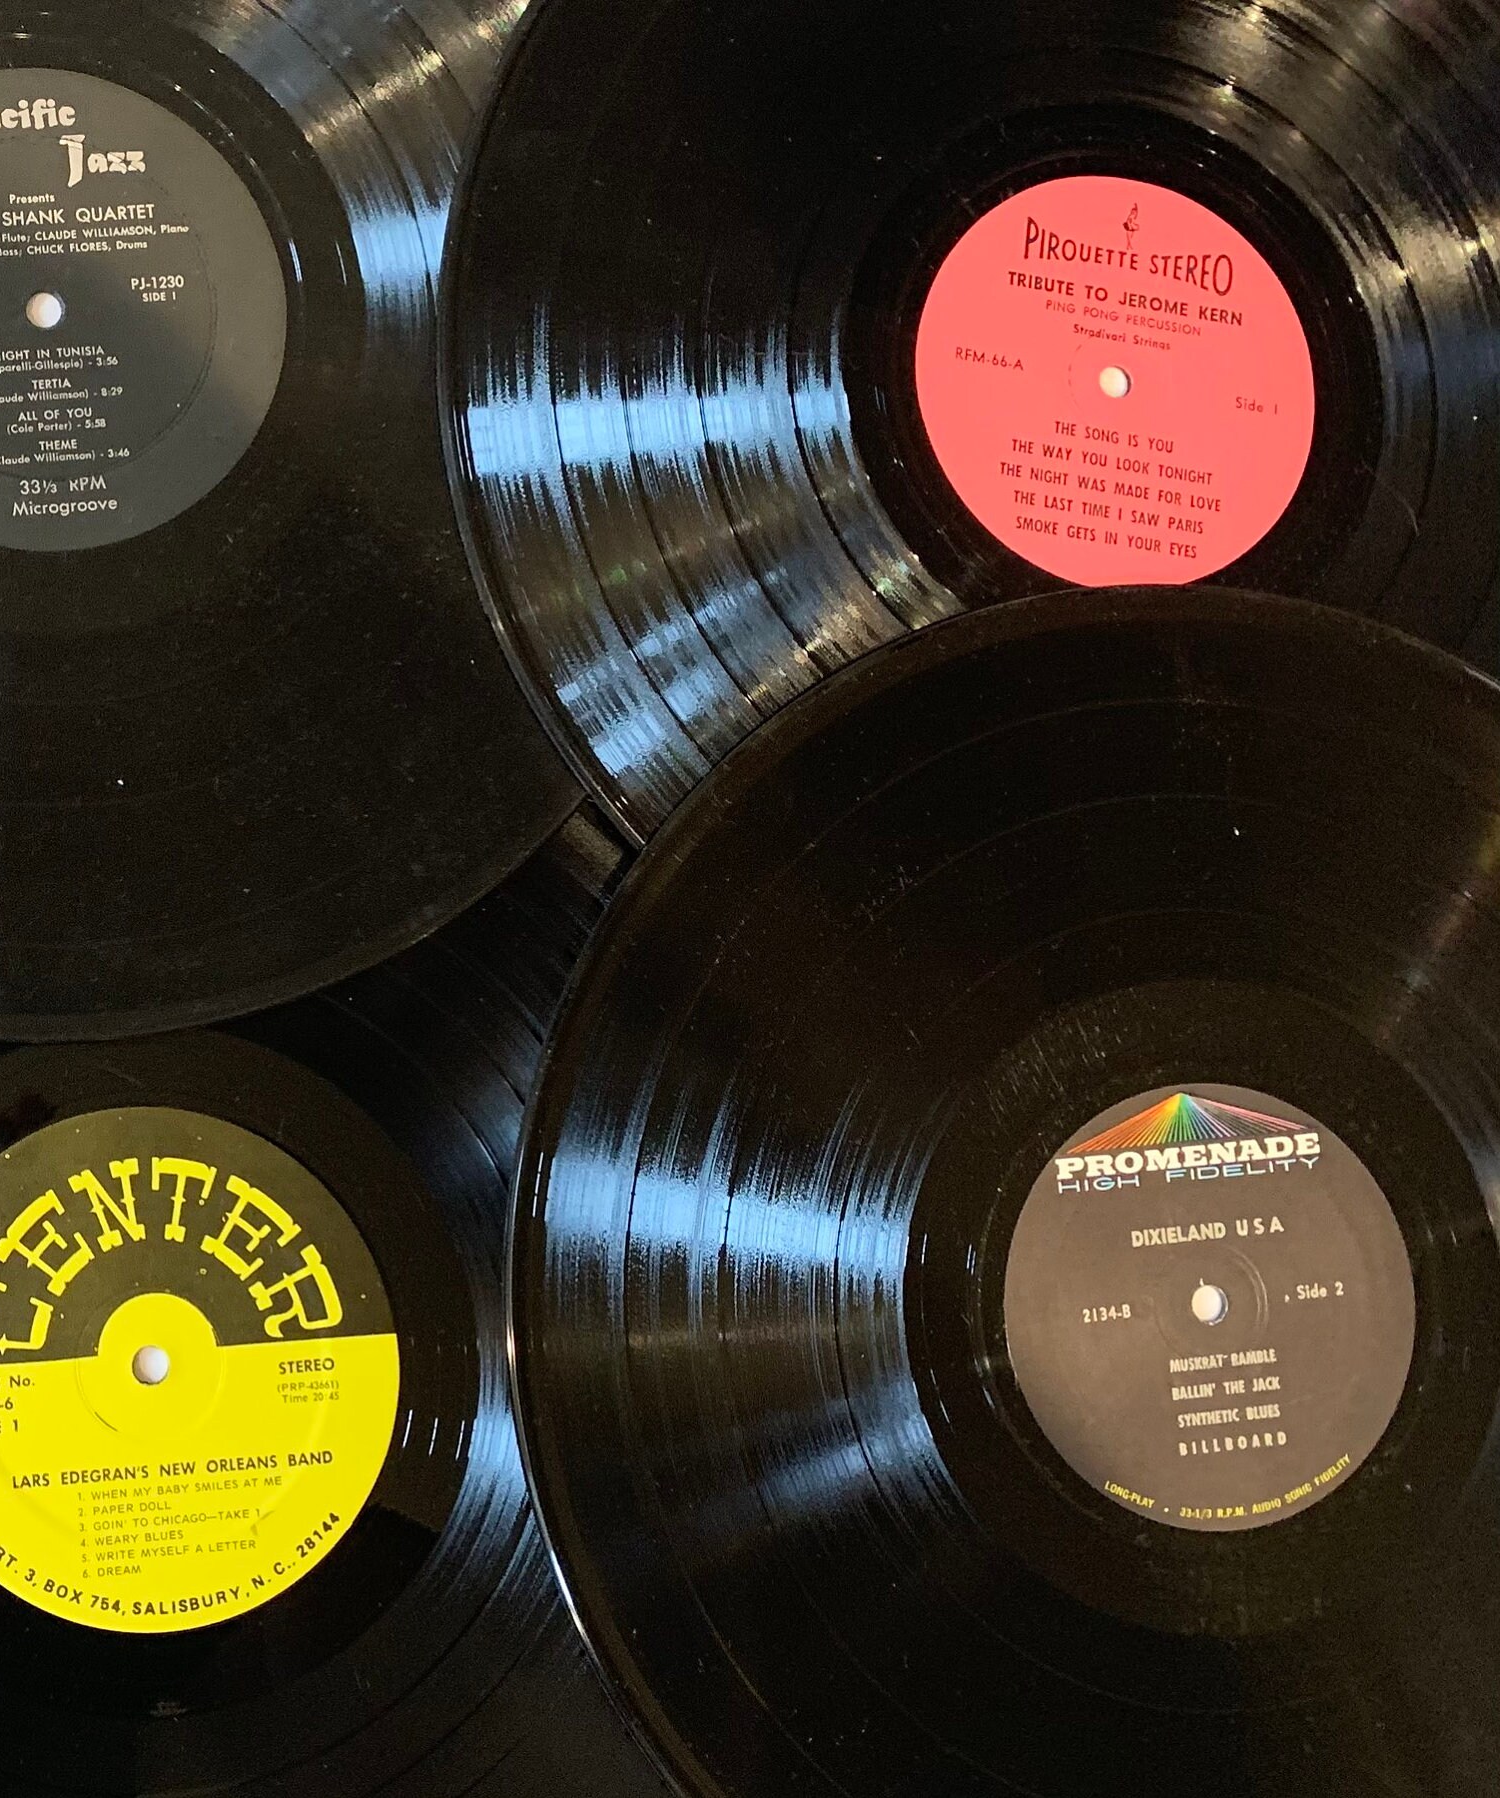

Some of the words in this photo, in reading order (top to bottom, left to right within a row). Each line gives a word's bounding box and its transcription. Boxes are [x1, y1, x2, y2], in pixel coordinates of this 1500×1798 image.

[59, 134, 146, 188] Jazz
[9, 193, 55, 205] Presents
[2, 208, 65, 227] SHANK
[76, 204, 155, 222] QUARTET
[35, 229, 77, 242] CLAUDE
[82, 225, 157, 239] WILLIAMSON,
[161, 224, 189, 234] Piano
[27, 243, 64, 255] CHUCK
[69, 241, 111, 254] FLORES,
[116, 240, 147, 250] Drums
[1024, 216, 1138, 271] PIROUETTE
[1149, 254, 1233, 296] STEREO
[130, 276, 184, 291] PJ-1230
[142, 291, 166, 303] SIDE
[1008, 271, 1075, 297] TRIBUTE
[1085, 285, 1108, 301] TO
[1118, 291, 1189, 317] JEROME
[1199, 306, 1243, 326] KERN
[1045, 299, 1076, 314] PING
[1083, 306, 1119, 322] PONG
[1126, 313, 1201, 336] PERCUSSION
[1072, 324, 1127, 343] Stradivari
[36, 348, 51, 359] IN
[56, 345, 105, 357] TUNISIA
[955, 347, 1024, 372] RFM-66-A
[31, 378, 71, 390] TERTIA
[18, 411, 38, 422] ALL
[43, 409, 60, 420] OF
[67, 407, 92, 418] YOU
[1235, 396, 1264, 413] Side
[38, 439, 78, 451] THEME
[1055, 421, 1076, 437] THE
[1084, 426, 1119, 444] SONG
[1128, 434, 1139, 448] IS
[1147, 437, 1174, 453] YOU
[1012, 439, 1034, 455] THE
[1042, 444, 1072, 461] WAY
[1081, 451, 1107, 467] YOU
[1116, 458, 1150, 475] LOOK
[1158, 464, 1213, 486] TONIGHT
[12, 498, 118, 517] Microgroove
[1016, 516, 1058, 536] SMOKE
[1067, 525, 1096, 542] GETS
[1104, 531, 1118, 545] IN
[1127, 535, 1161, 554] YOUR
[1169, 543, 1197, 559] EYES
[1054, 1132, 1320, 1181] PROMENADE
[1058, 1175, 1140, 1194] HIGH
[1166, 1157, 1319, 1183] FIDELITY
[1131, 1222, 1226, 1248] DIXIELAND
[1296, 1284, 1327, 1300] Side
[1335, 1281, 1344, 1296] 2
[1082, 1304, 1132, 1324] 2134-B
[278, 1357, 335, 1374] STEREO
[1170, 1355, 1224, 1373] MUSKRAT
[1231, 1348, 1277, 1367] RAMBLE
[9, 1373, 35, 1388] No.
[1172, 1383, 1216, 1401] BALLIN'
[1223, 1380, 1245, 1396] THE
[1252, 1376, 1280, 1392] JACK
[12, 1418, 19, 1433] 1
[1177, 1408, 1240, 1428] SYNTHETIC
[1246, 1403, 1281, 1420] BLUES
[12, 1472, 50, 1490] LARS
[60, 1464, 150, 1485] EDEGRAN'S
[159, 1461, 196, 1477] NEW
[206, 1454, 278, 1472] ORLEANS
[287, 1449, 334, 1467] BAND
[1104, 1480, 1156, 1510] LONG-PLAY
[1252, 1497, 1282, 1515] AUDIO
[1284, 1483, 1312, 1505] SONIC
[1314, 1453, 1351, 1487] FIDELITY
[25, 1567, 38, 1587] 3,
[43, 1579, 84, 1605] BOX
[132, 1585, 250, 1616] SALISBURY,
[295, 1511, 341, 1559] 28144
